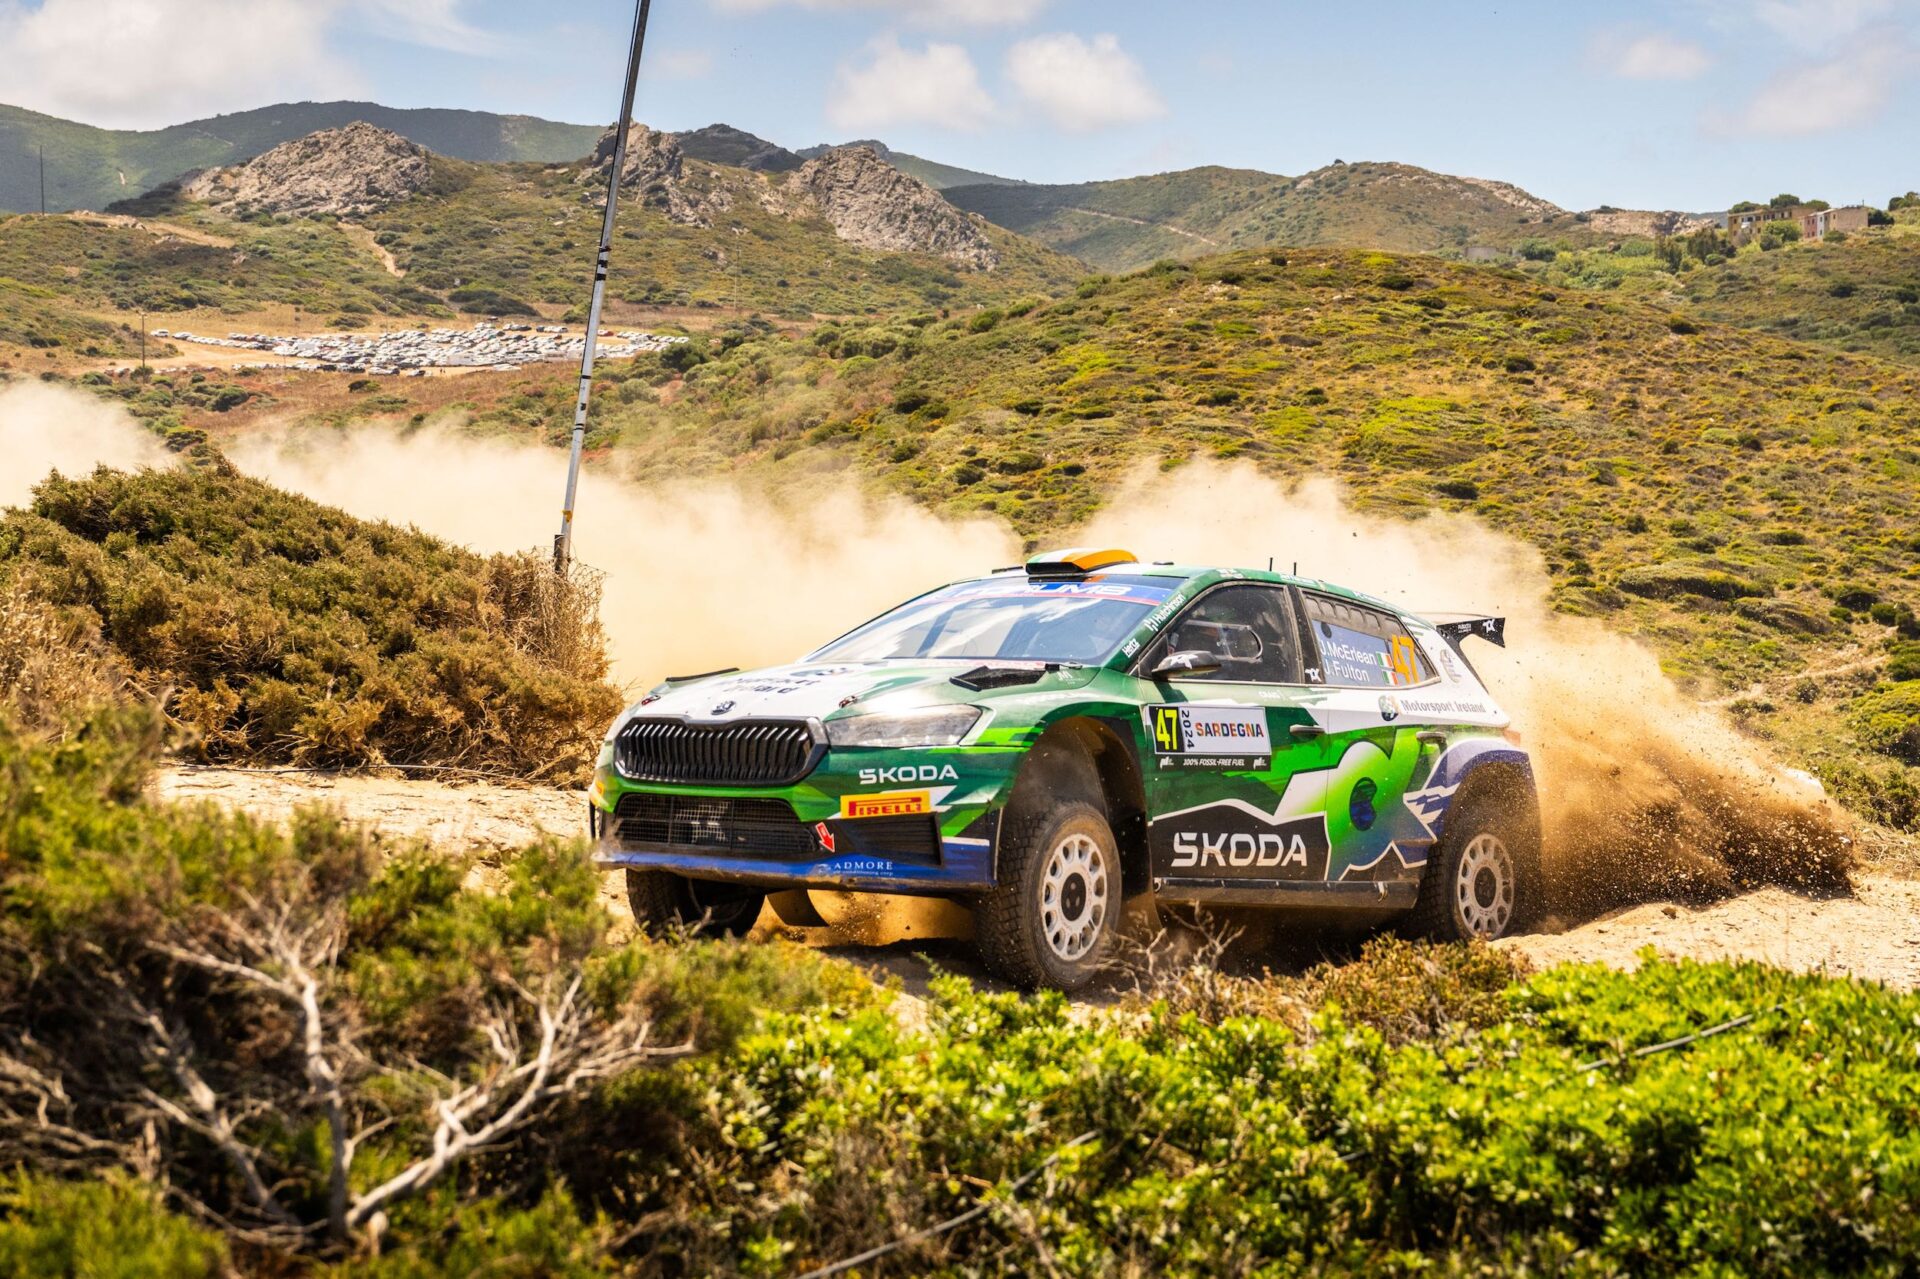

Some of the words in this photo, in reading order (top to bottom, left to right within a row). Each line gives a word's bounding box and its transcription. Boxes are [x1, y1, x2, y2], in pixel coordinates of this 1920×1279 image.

[1320, 640, 1378, 666] J.McErlean
[1391, 634, 1419, 684] 47
[1323, 658, 1370, 682] J.Fulton
[1400, 700, 1454, 714] Motorsport
[1455, 701, 1487, 713] Ireland
[1156, 708, 1178, 750] 47
[1181, 709, 1195, 749] 2024
[1195, 722, 1264, 738] SARDEGNA
[1231, 758, 1245, 766] FUEL
[848, 797, 922, 817] PIRELLI
[834, 861, 894, 871] ADMORE
